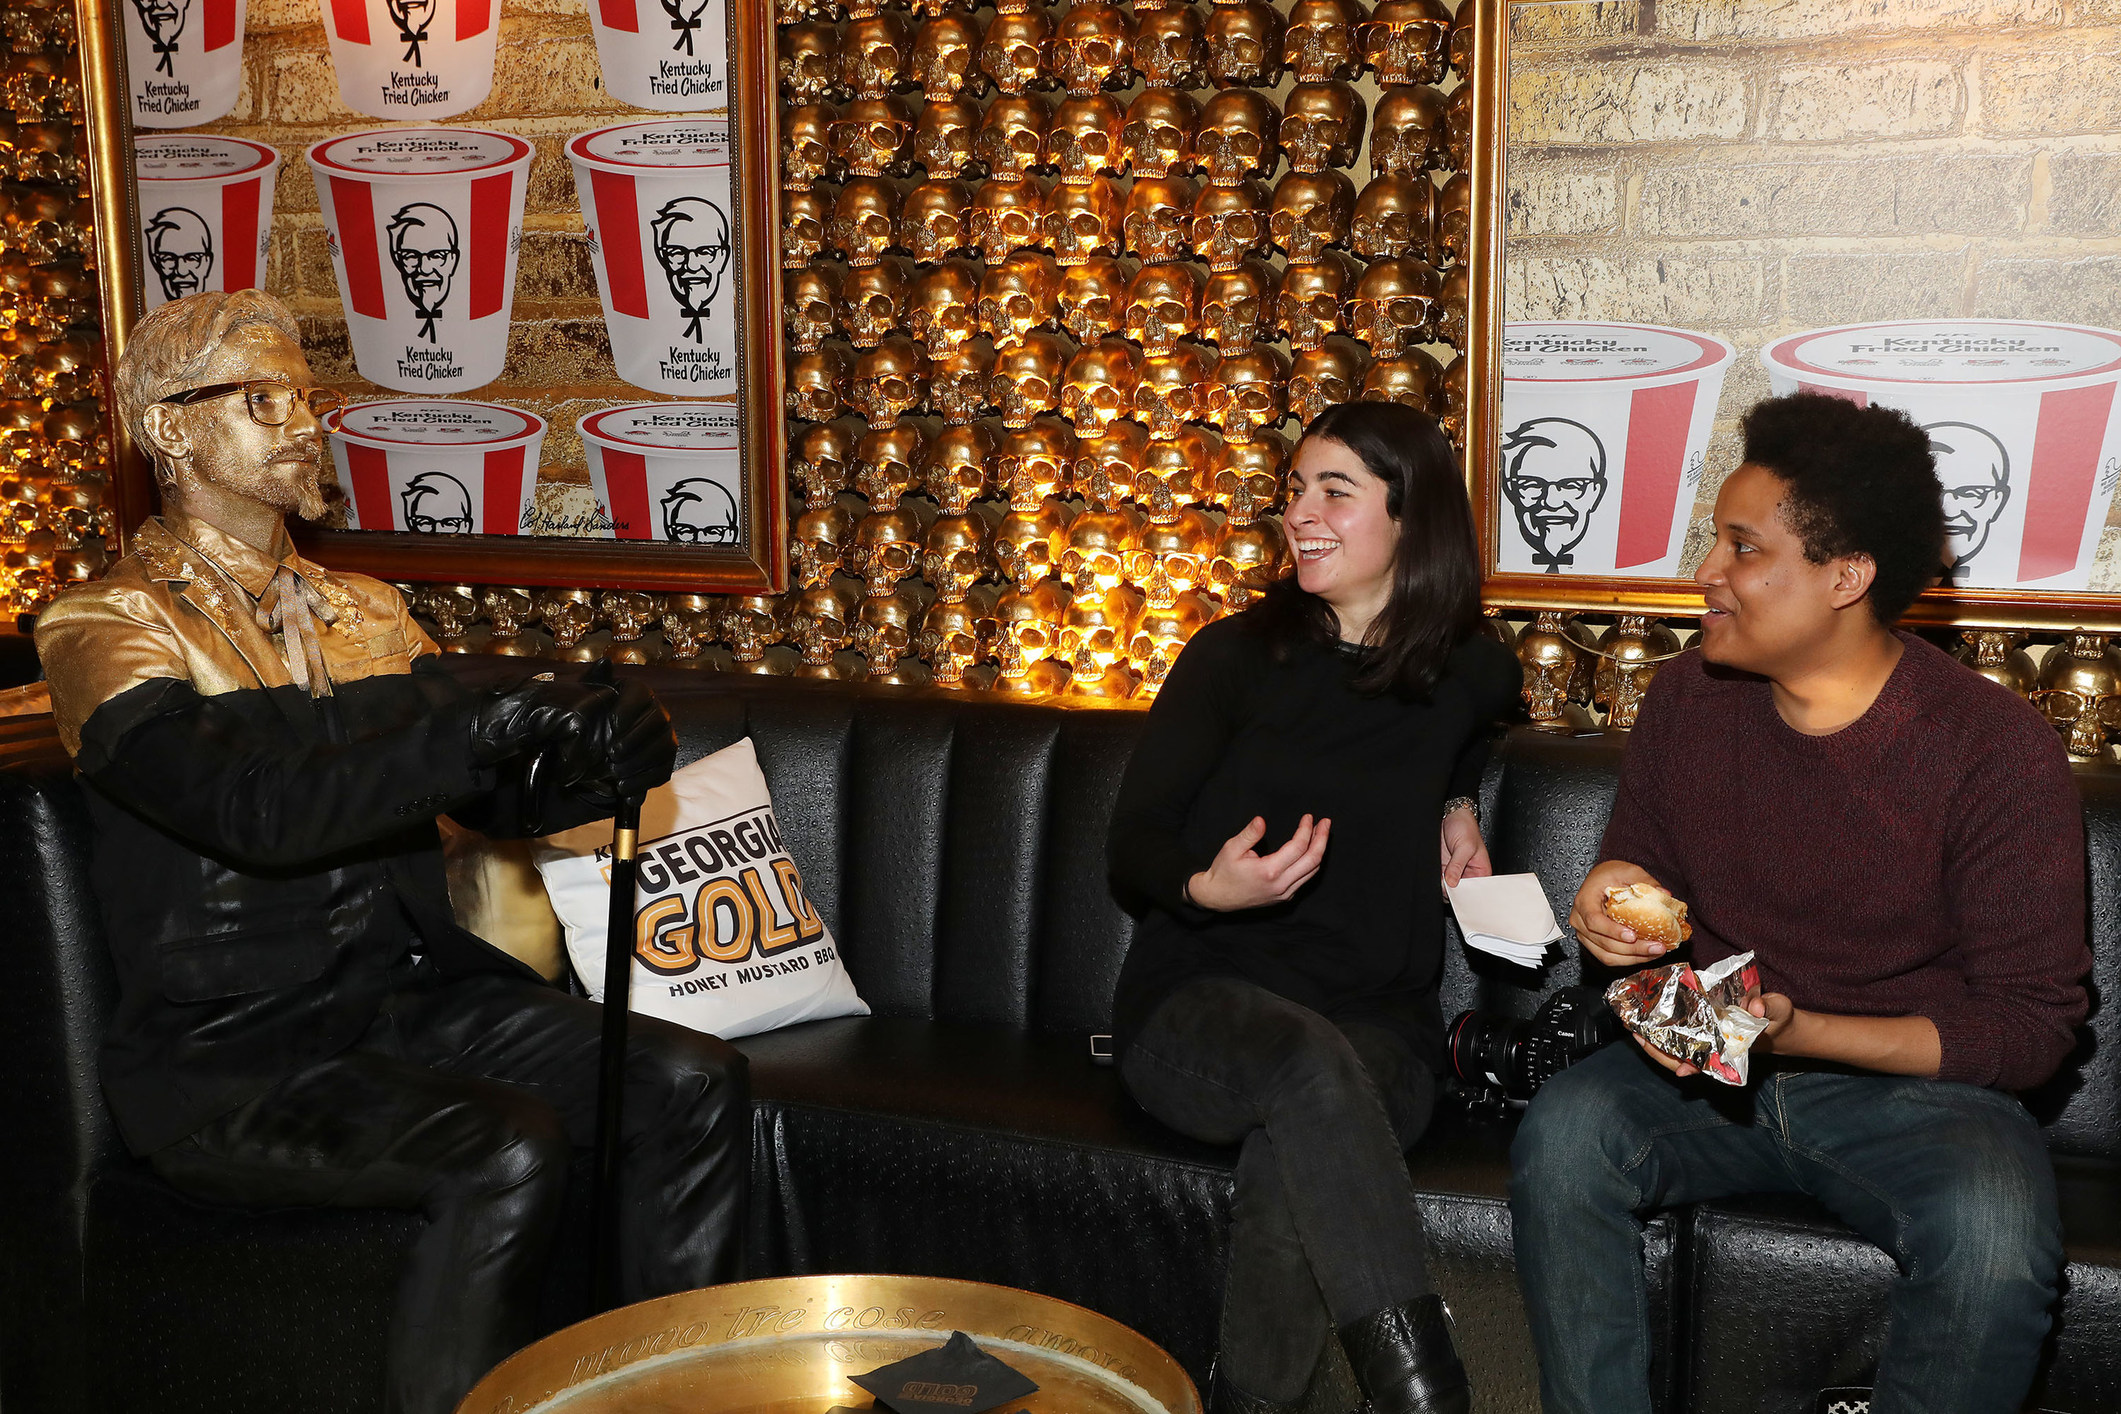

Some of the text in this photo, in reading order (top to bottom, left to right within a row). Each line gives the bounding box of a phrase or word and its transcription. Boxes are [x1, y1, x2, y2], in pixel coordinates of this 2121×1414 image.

[660, 60, 711, 79] Kentucky
[145, 81, 190, 98] Kentucky
[391, 71, 438, 89] Kentucky
[649, 76, 723, 97] Fried Chicken
[137, 95, 199, 115] Fried Chicken
[382, 86, 448, 107] Fried Chicken
[357, 146, 403, 154] Fried
[376, 140, 459, 148] Kentucky
[621, 138, 671, 146] Fried
[1538, 345, 1648, 353] Chicken
[1849, 344, 2061, 353] Fried Chicken
[1883, 338, 2026, 347] Kentucky
[405, 345, 453, 364] Kentucky
[669, 346, 720, 365] Kentucky
[397, 360, 463, 381] Fried Chicken
[659, 361, 731, 383] Fried Chicken
[391, 411, 473, 419] Kentucky
[583, 508, 630, 533] Sanders
[636, 814, 785, 894] GEORGIA
[633, 858, 825, 976] GOLD
[668, 947, 837, 997] HONEY MUSTARD BBQ
[1557, 1030, 1575, 1038] Canon
[822, 1305, 948, 1331] cose
